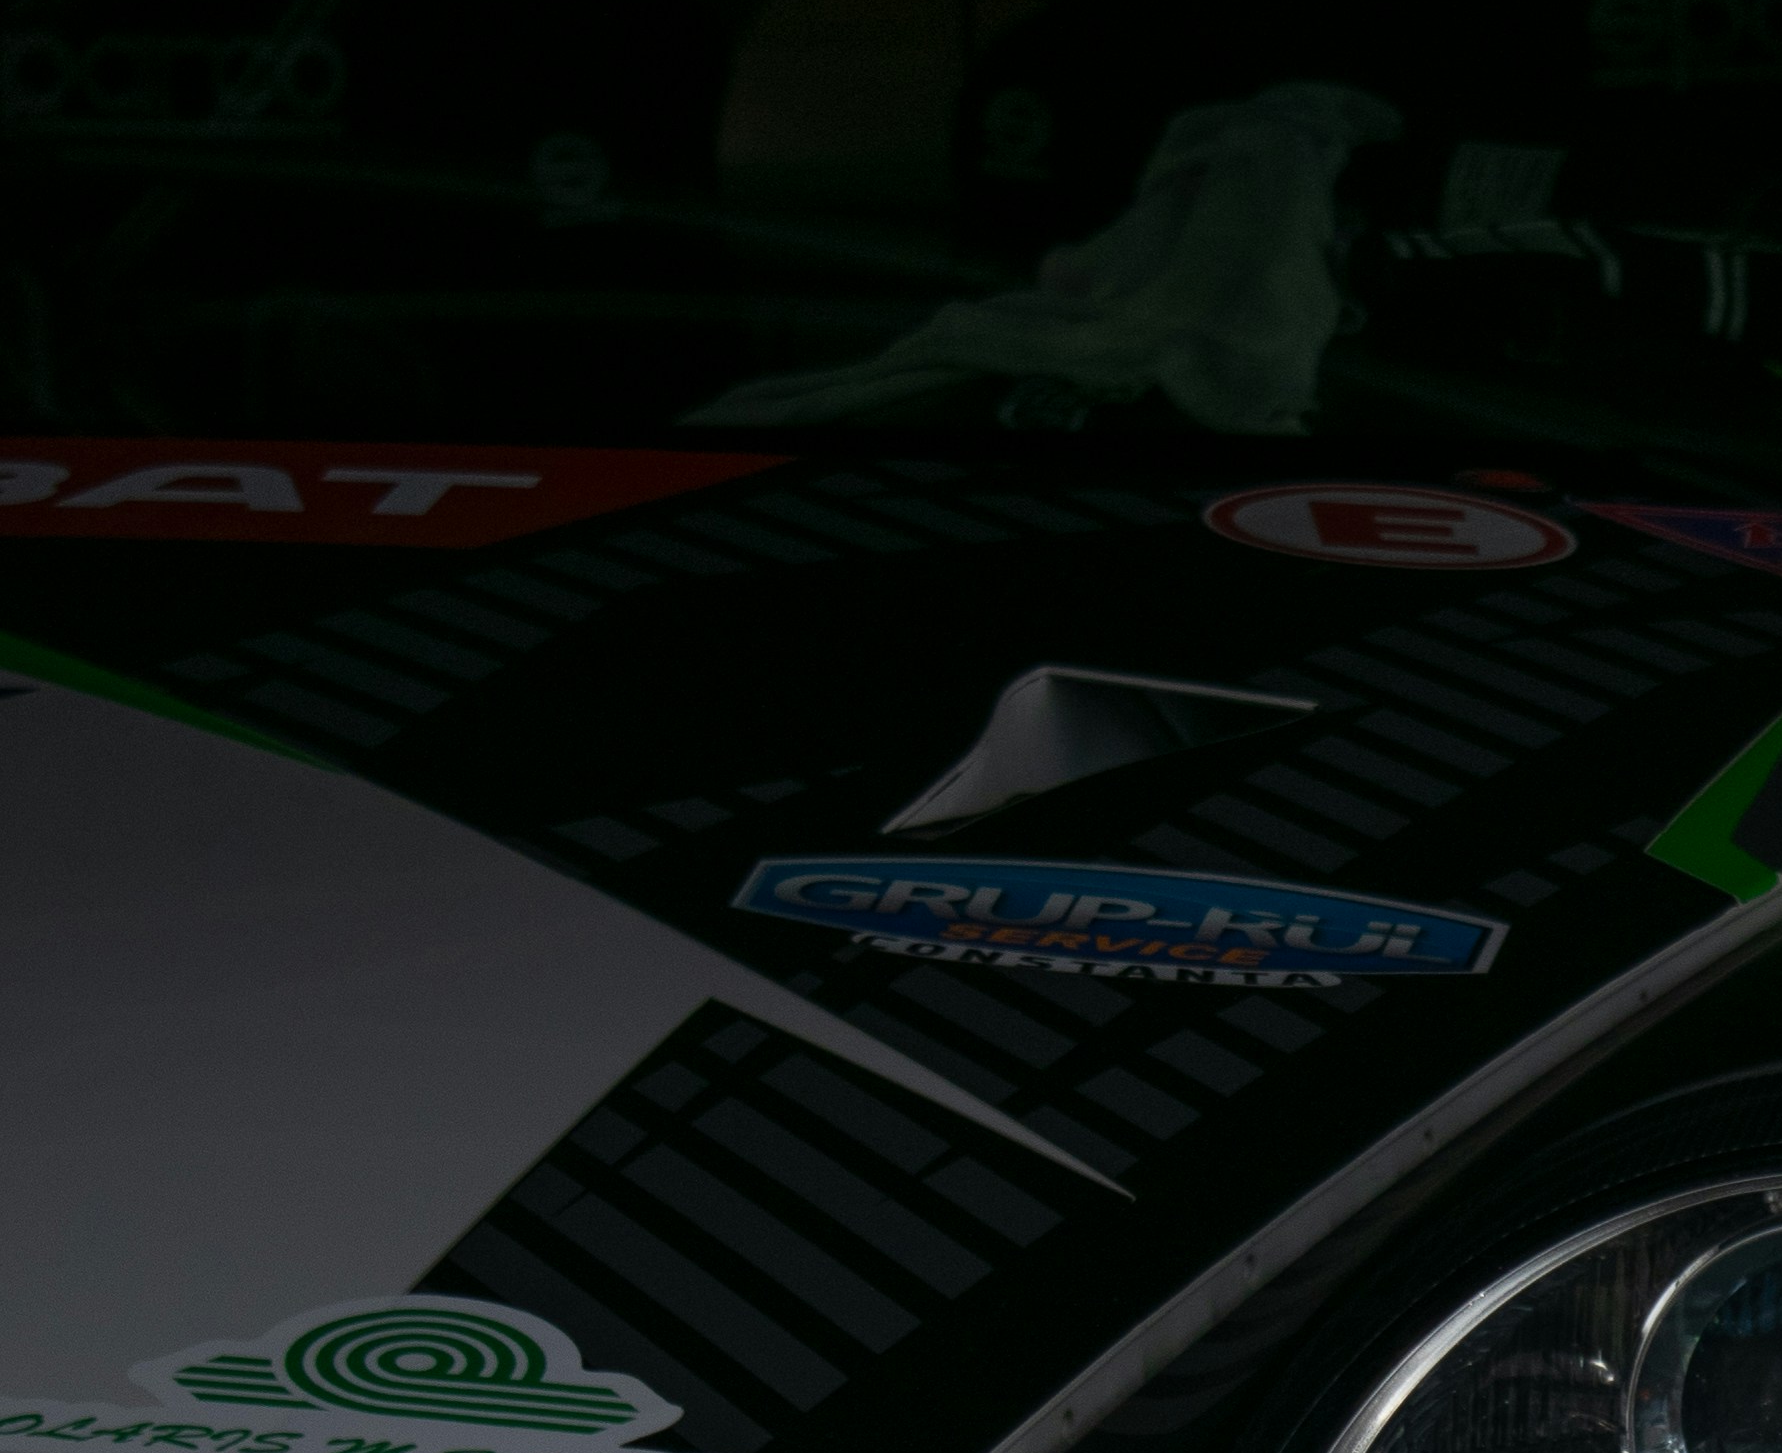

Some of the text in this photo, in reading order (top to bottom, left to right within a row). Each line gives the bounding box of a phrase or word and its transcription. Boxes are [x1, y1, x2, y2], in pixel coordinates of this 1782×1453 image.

[1308, 501, 1479, 555] E
[853, 933, 1325, 987] CONSTANTA
[936, 920, 1273, 967] SERVICE
